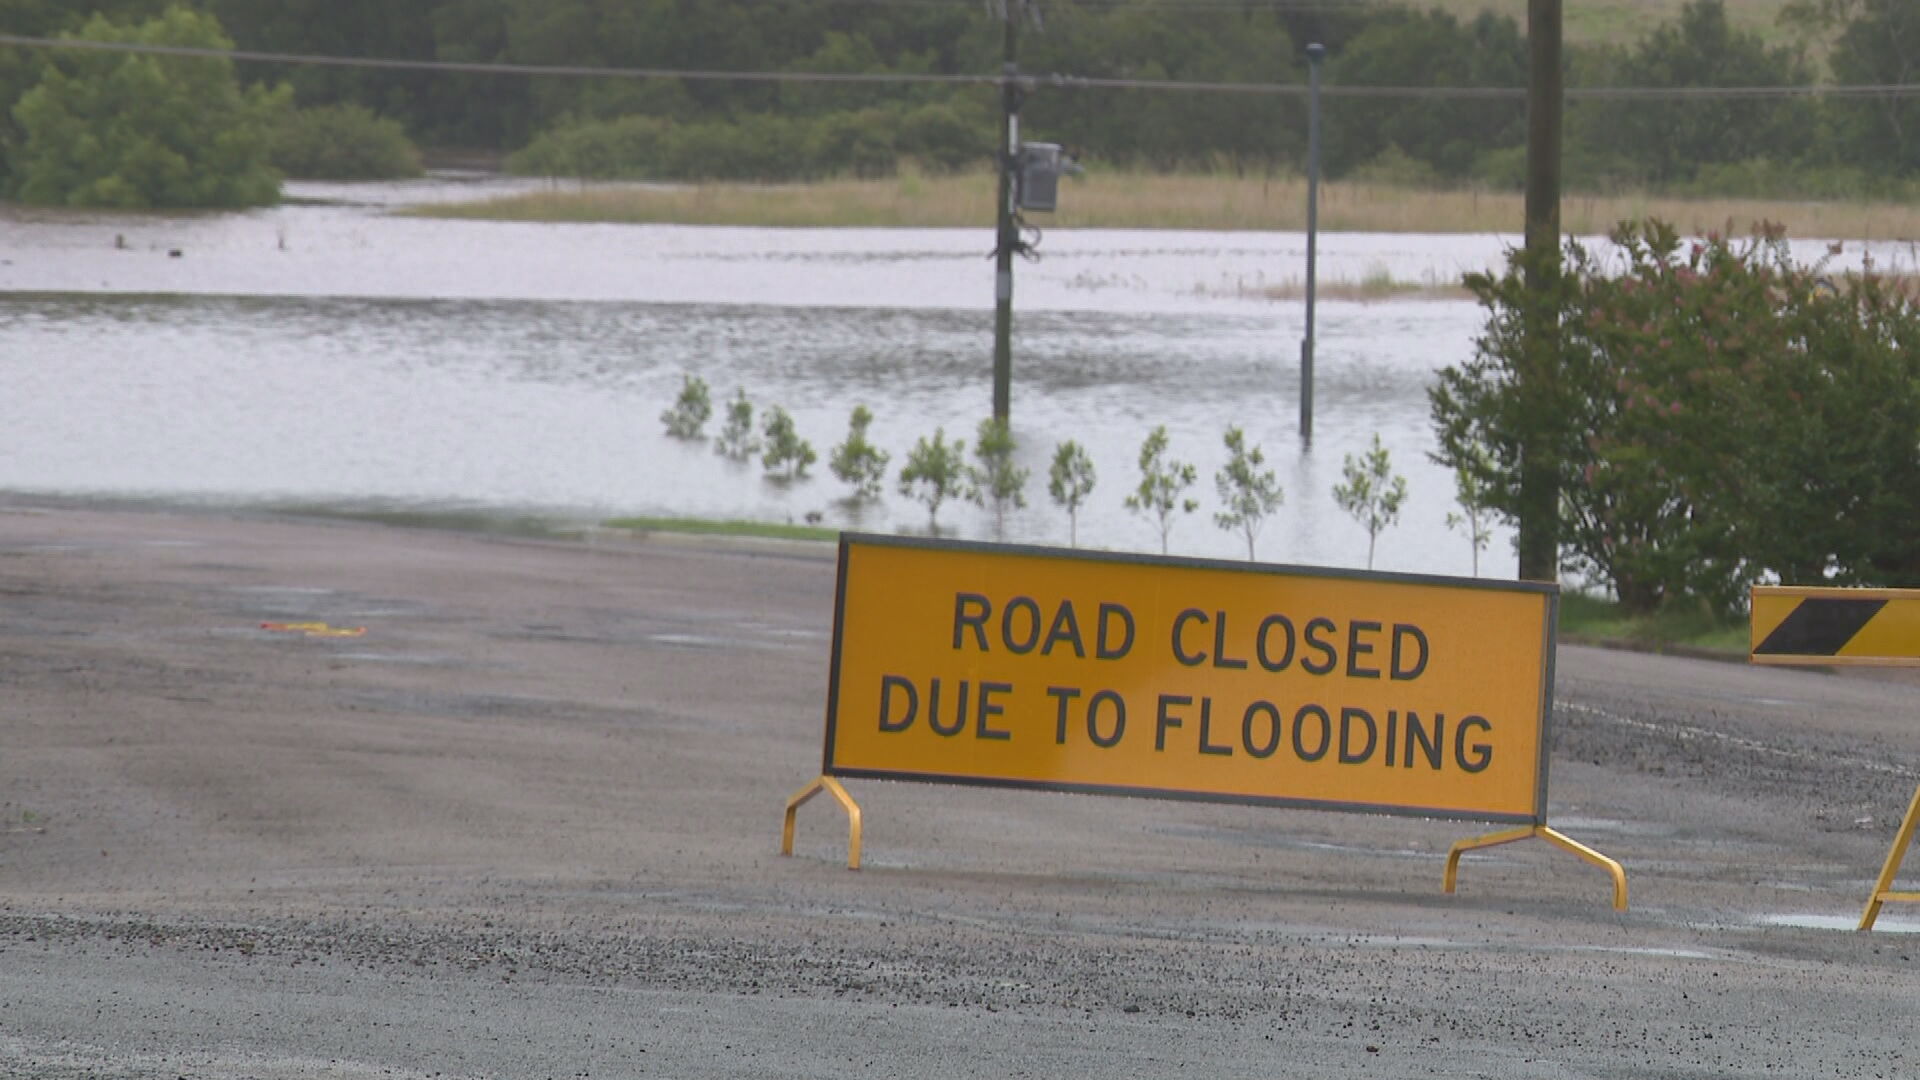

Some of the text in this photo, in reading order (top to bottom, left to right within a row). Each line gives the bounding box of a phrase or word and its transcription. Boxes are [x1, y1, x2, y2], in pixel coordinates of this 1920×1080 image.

[951, 591, 1430, 682] ROAD CLOSED
[877, 674, 1494, 774] DUE TO FLOODING
